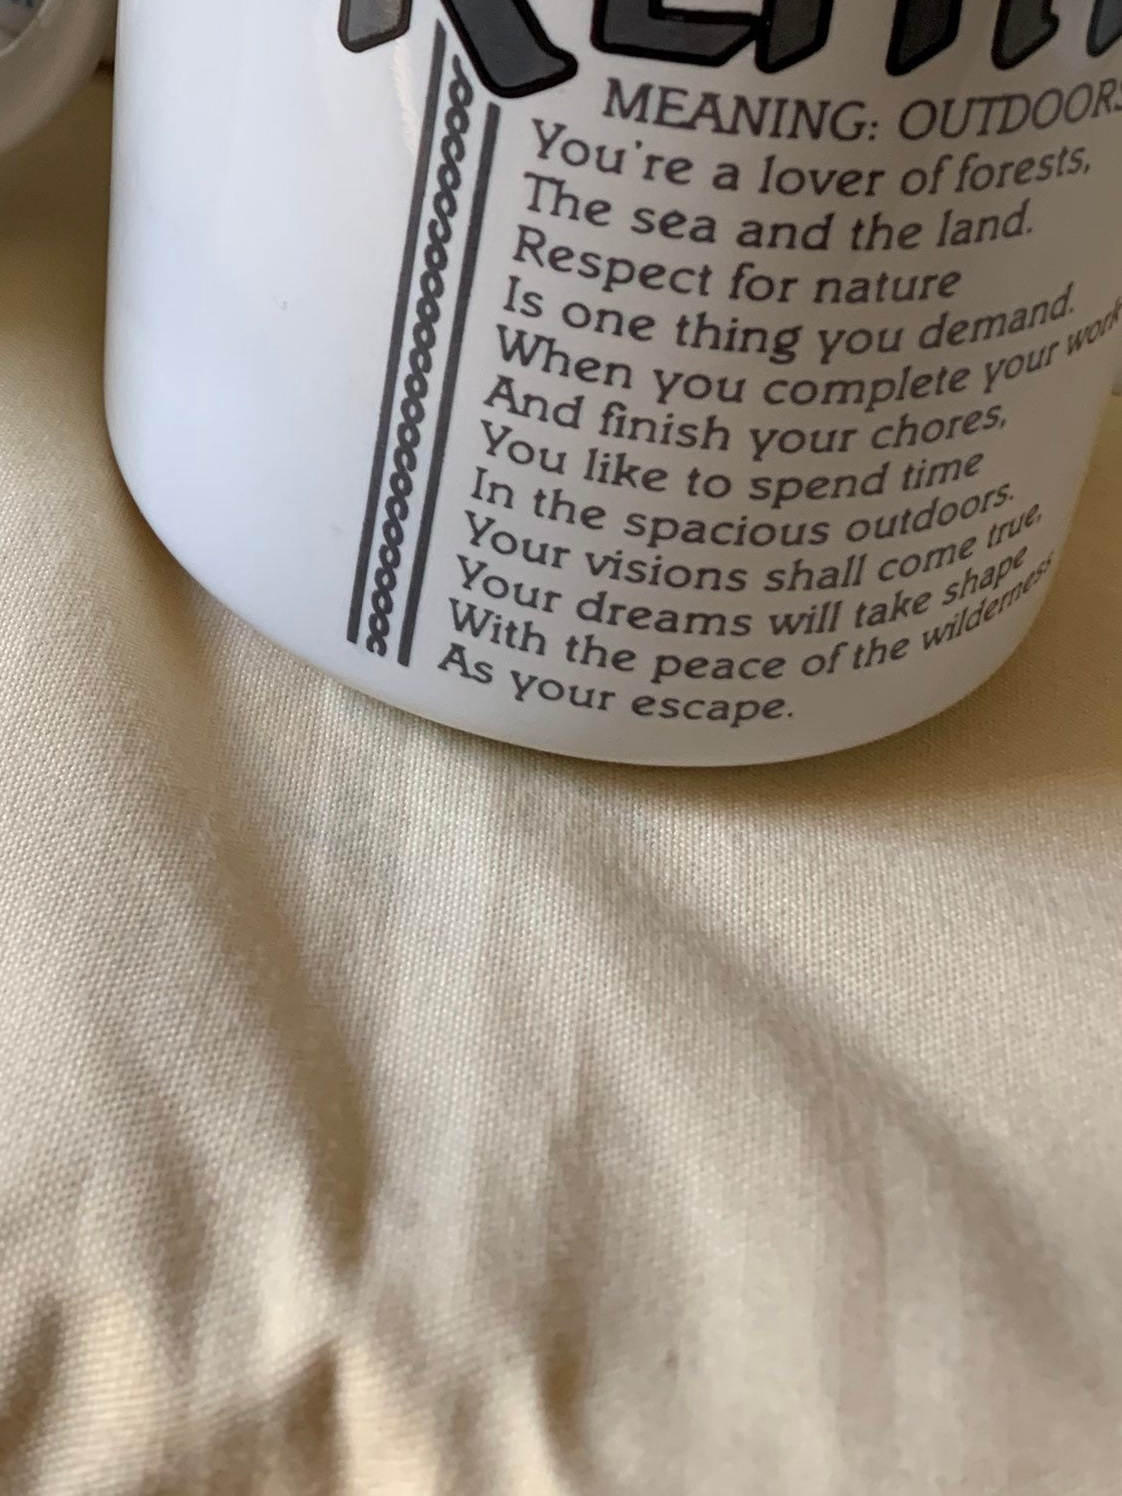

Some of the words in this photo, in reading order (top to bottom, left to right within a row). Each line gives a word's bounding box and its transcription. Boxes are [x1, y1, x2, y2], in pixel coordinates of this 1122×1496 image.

[602, 78, 878, 141] MEANING:
[532, 119, 693, 185] You're
[712, 163, 739, 191] a
[758, 155, 886, 197] lover
[900, 154, 953, 196] of
[955, 146, 1090, 192] forests,
[524, 172, 611, 226] The
[631, 208, 716, 243] sea
[736, 213, 835, 250] and
[851, 212, 922, 251] the
[936, 198, 1032, 247] land.
[513, 224, 712, 301] Respect
[729, 262, 798, 303] for
[813, 271, 961, 304] nature
[503, 275, 543, 317] Is
[562, 302, 655, 341] one
[676, 312, 803, 365] thing
[818, 322, 904, 365] you
[919, 281, 1074, 349] demand.
[496, 324, 632, 389] When
[653, 369, 746, 404] you
[764, 370, 970, 413] complete
[984, 341, 1059, 394] your
[483, 375, 585, 429] And
[599, 401, 730, 451] finish
[750, 429, 858, 462] your
[871, 405, 1005, 449] chores,
[471, 466, 513, 509] In
[534, 489, 606, 530] the
[624, 513, 830, 548] spacious
[846, 483, 1013, 542] outdoors.
[481, 420, 567, 475] You
[584, 448, 668, 492] like
[688, 468, 731, 498] to
[749, 456, 890, 509] spend
[902, 453, 984, 491] time
[457, 555, 562, 613] Your
[576, 591, 752, 636] dreams
[769, 605, 842, 635] will
[855, 590, 932, 628] take
[942, 546, 1028, 605] shape
[465, 510, 571, 568] Your
[585, 550, 747, 592] visions
[764, 553, 867, 592] shall
[878, 537, 977, 581] come
[449, 598, 545, 656] With
[566, 635, 636, 672] the
[651, 655, 786, 684] peace
[801, 642, 848, 676] of
[853, 637, 909, 670] the
[438, 643, 493, 684] As
[510, 670, 616, 711] your
[631, 696, 793, 728] escape.
